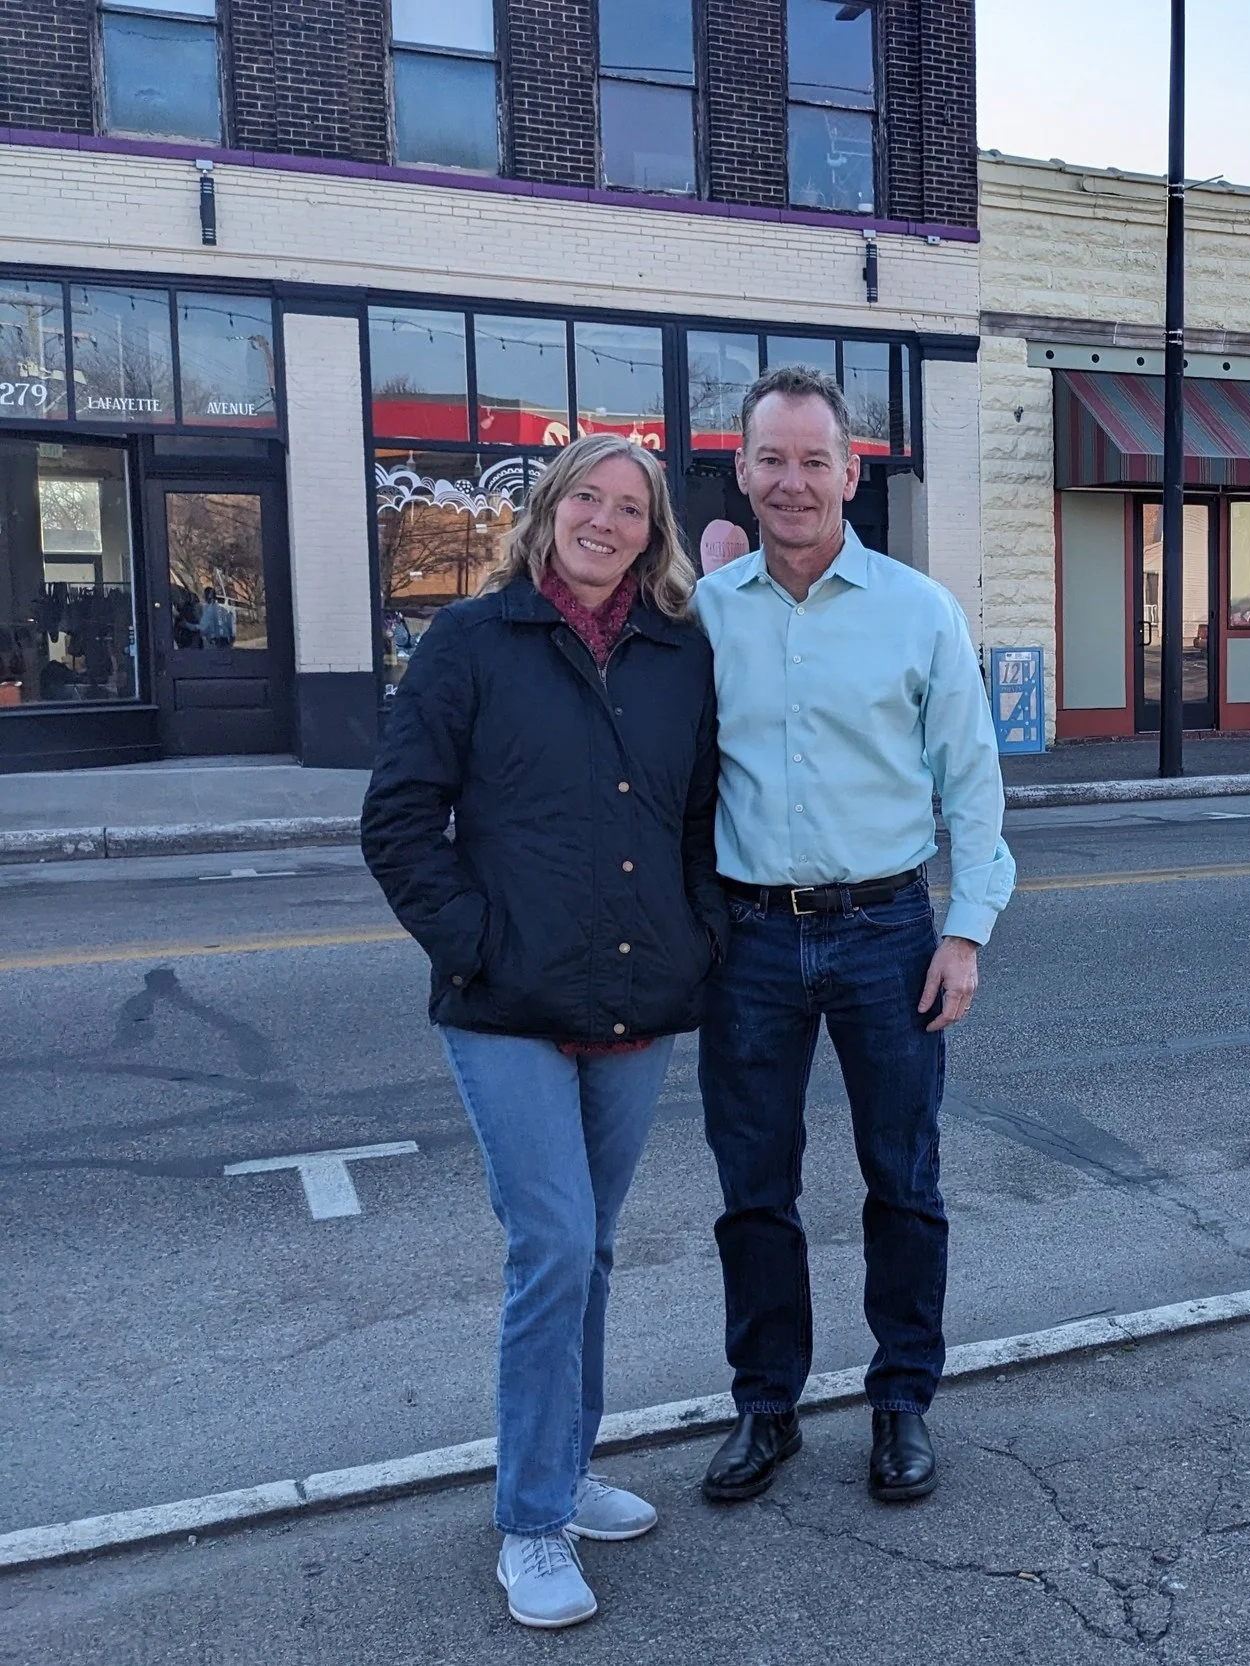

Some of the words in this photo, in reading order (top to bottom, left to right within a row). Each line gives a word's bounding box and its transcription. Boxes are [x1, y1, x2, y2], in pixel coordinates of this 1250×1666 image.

[0, 382, 48, 407] 279
[88, 396, 162, 412] LAFAYETTE
[206, 401, 258, 417] AVENUE
[1002, 663, 1020, 683] 12
